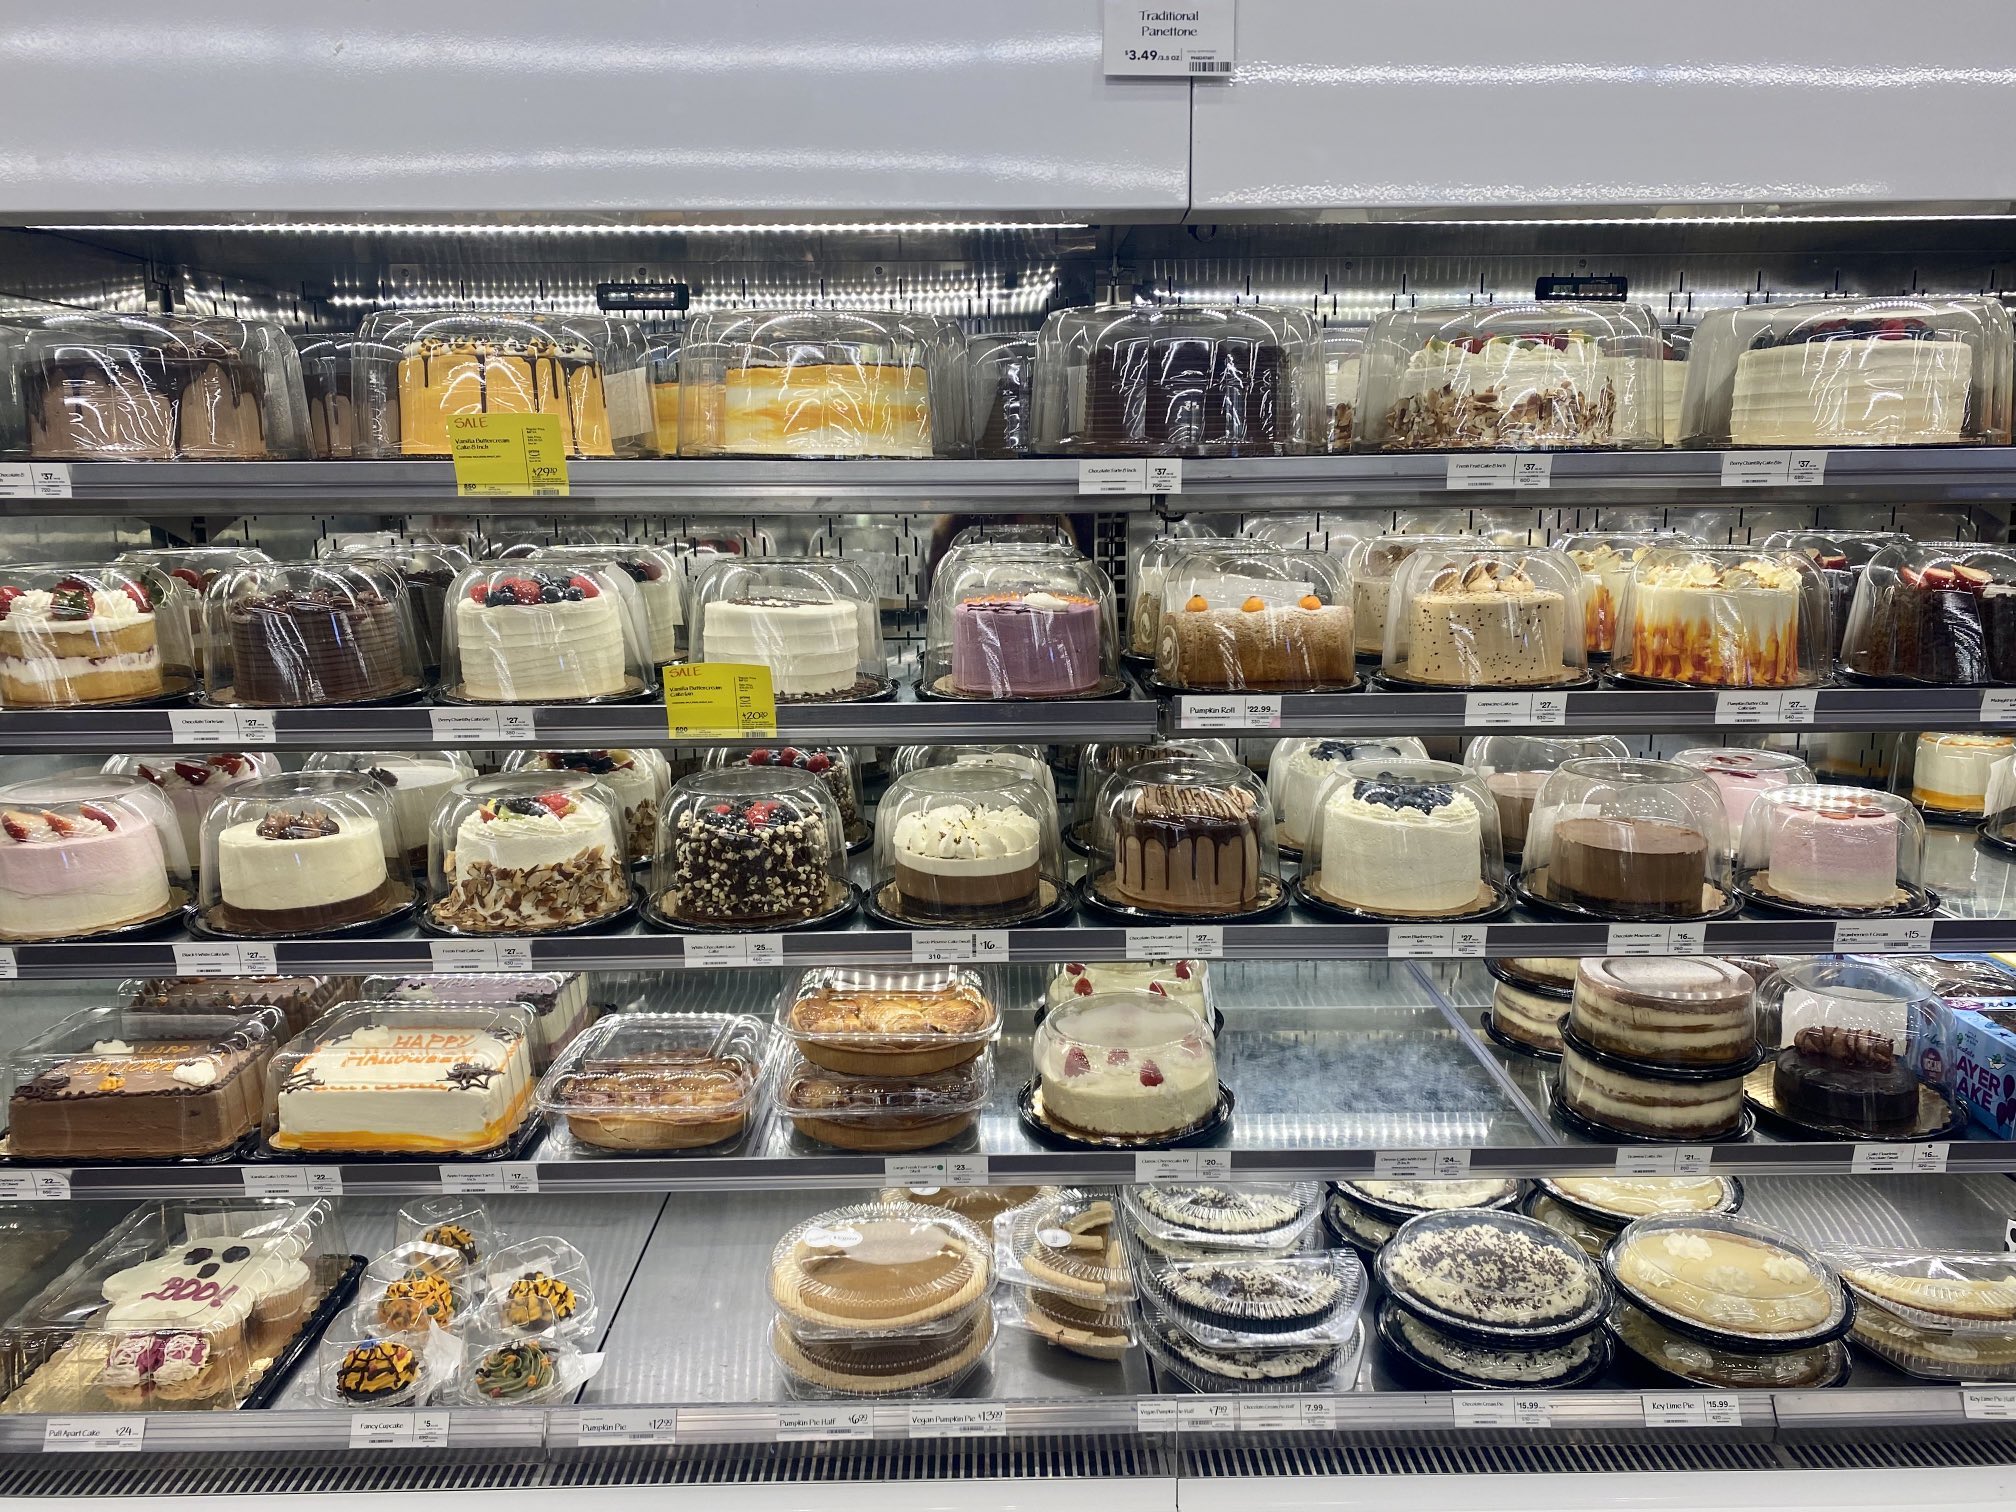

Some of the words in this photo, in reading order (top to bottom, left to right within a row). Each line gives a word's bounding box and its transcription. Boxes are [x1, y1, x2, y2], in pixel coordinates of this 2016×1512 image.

[1140, 10, 1199, 21] Traditional
[1141, 26, 1198, 36] Panettone
[454, 416, 488, 428] SALE
[669, 666, 702, 678] SALE
[980, 941, 995, 950] $16
[394, 1034, 474, 1049] HAPPY
[1957, 1056, 2000, 1096] AYER
[1957, 1077, 1993, 1112] AKE
[140, 1276, 240, 1308] BOO!
[912, 1416, 934, 1425] Vegan
[116, 1426, 132, 1436] $24
